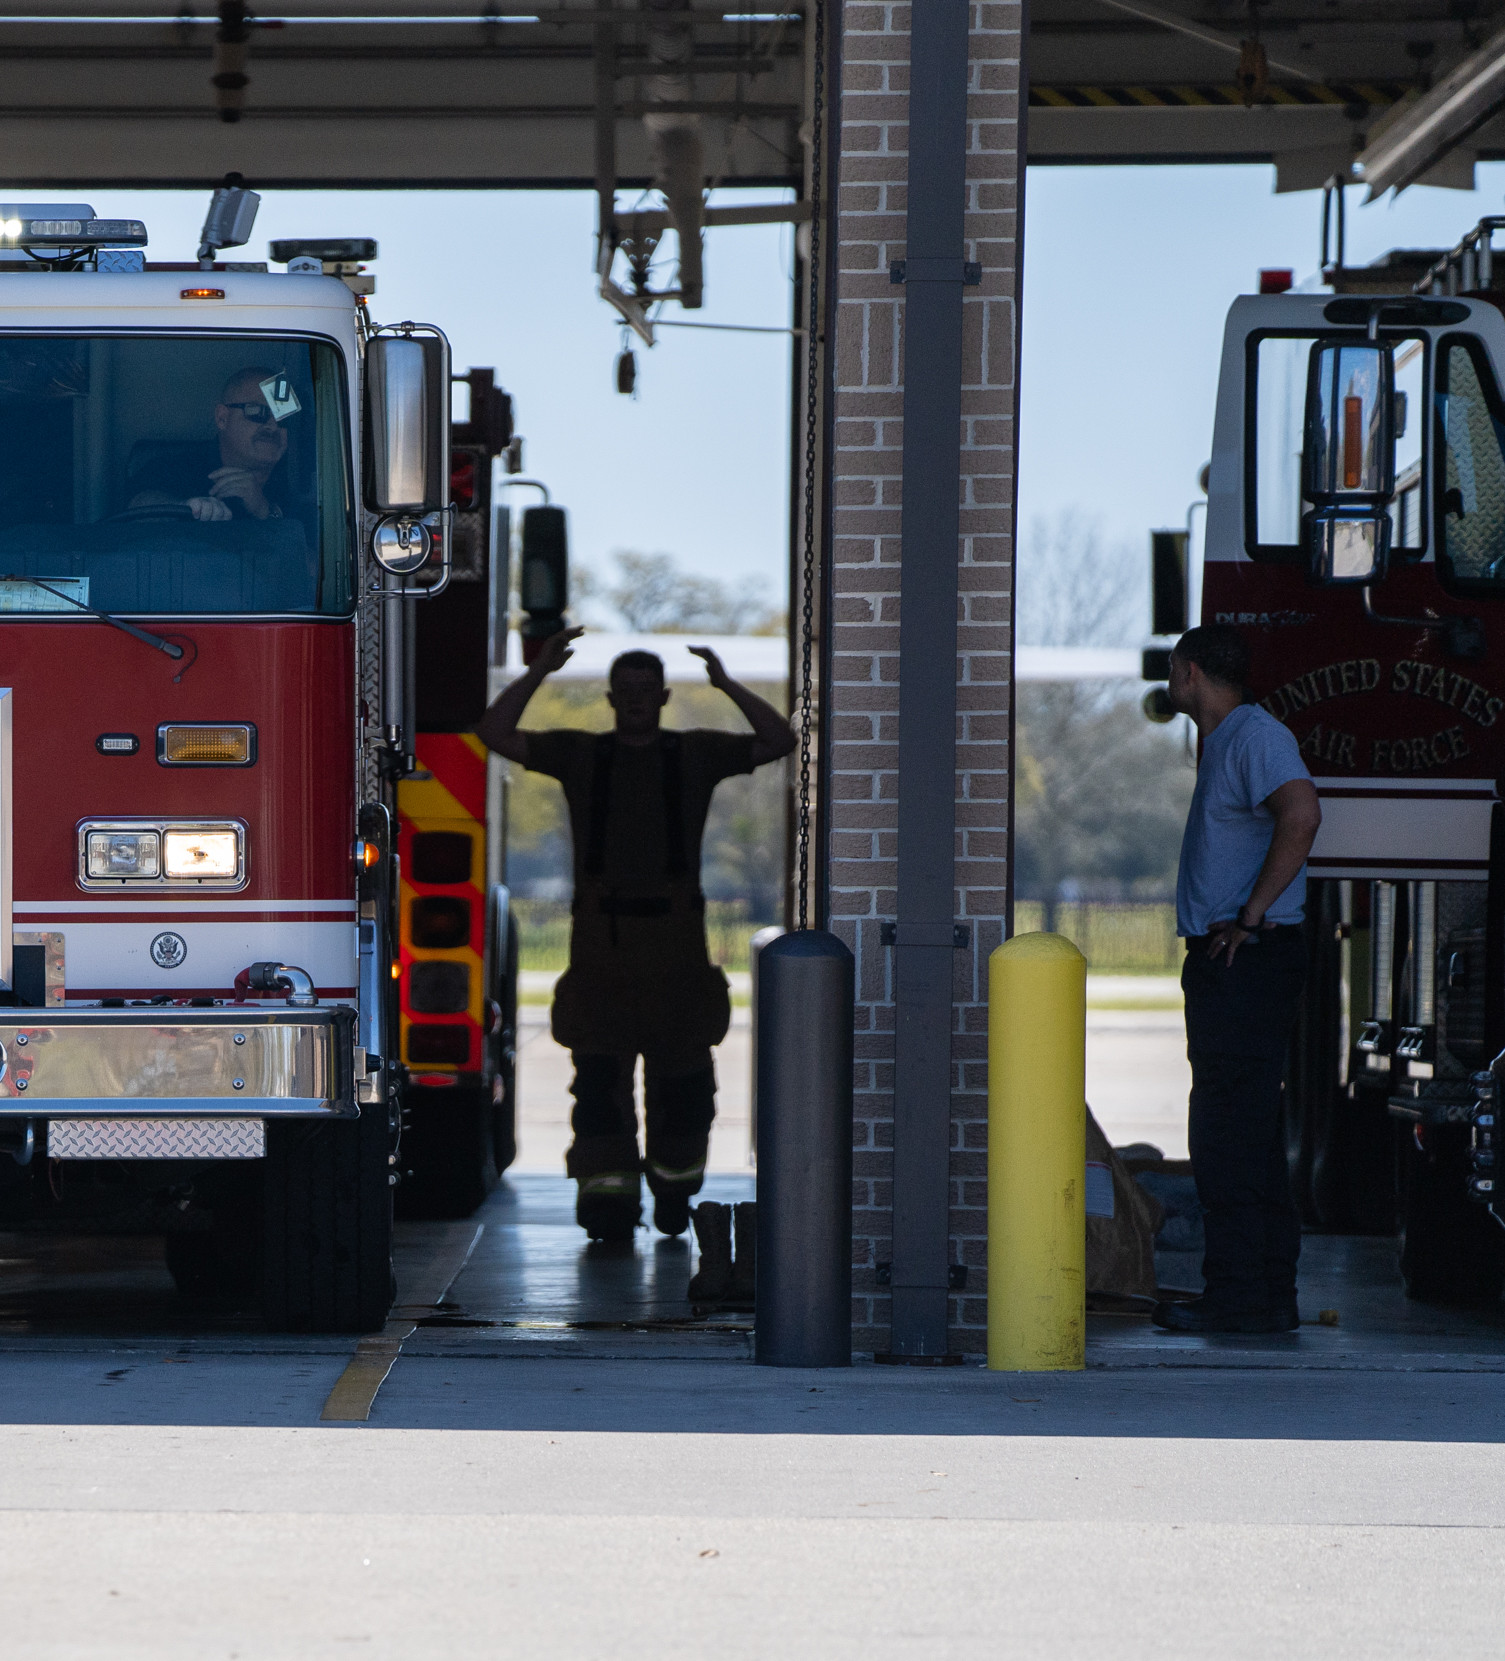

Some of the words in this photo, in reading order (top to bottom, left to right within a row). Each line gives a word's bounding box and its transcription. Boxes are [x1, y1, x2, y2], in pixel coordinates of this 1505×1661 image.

[1262, 658, 1382, 722] UNITED
[1392, 659, 1504, 727] STATES
[1299, 723, 1357, 768] AIR
[1371, 725, 1471, 772] FORCE
